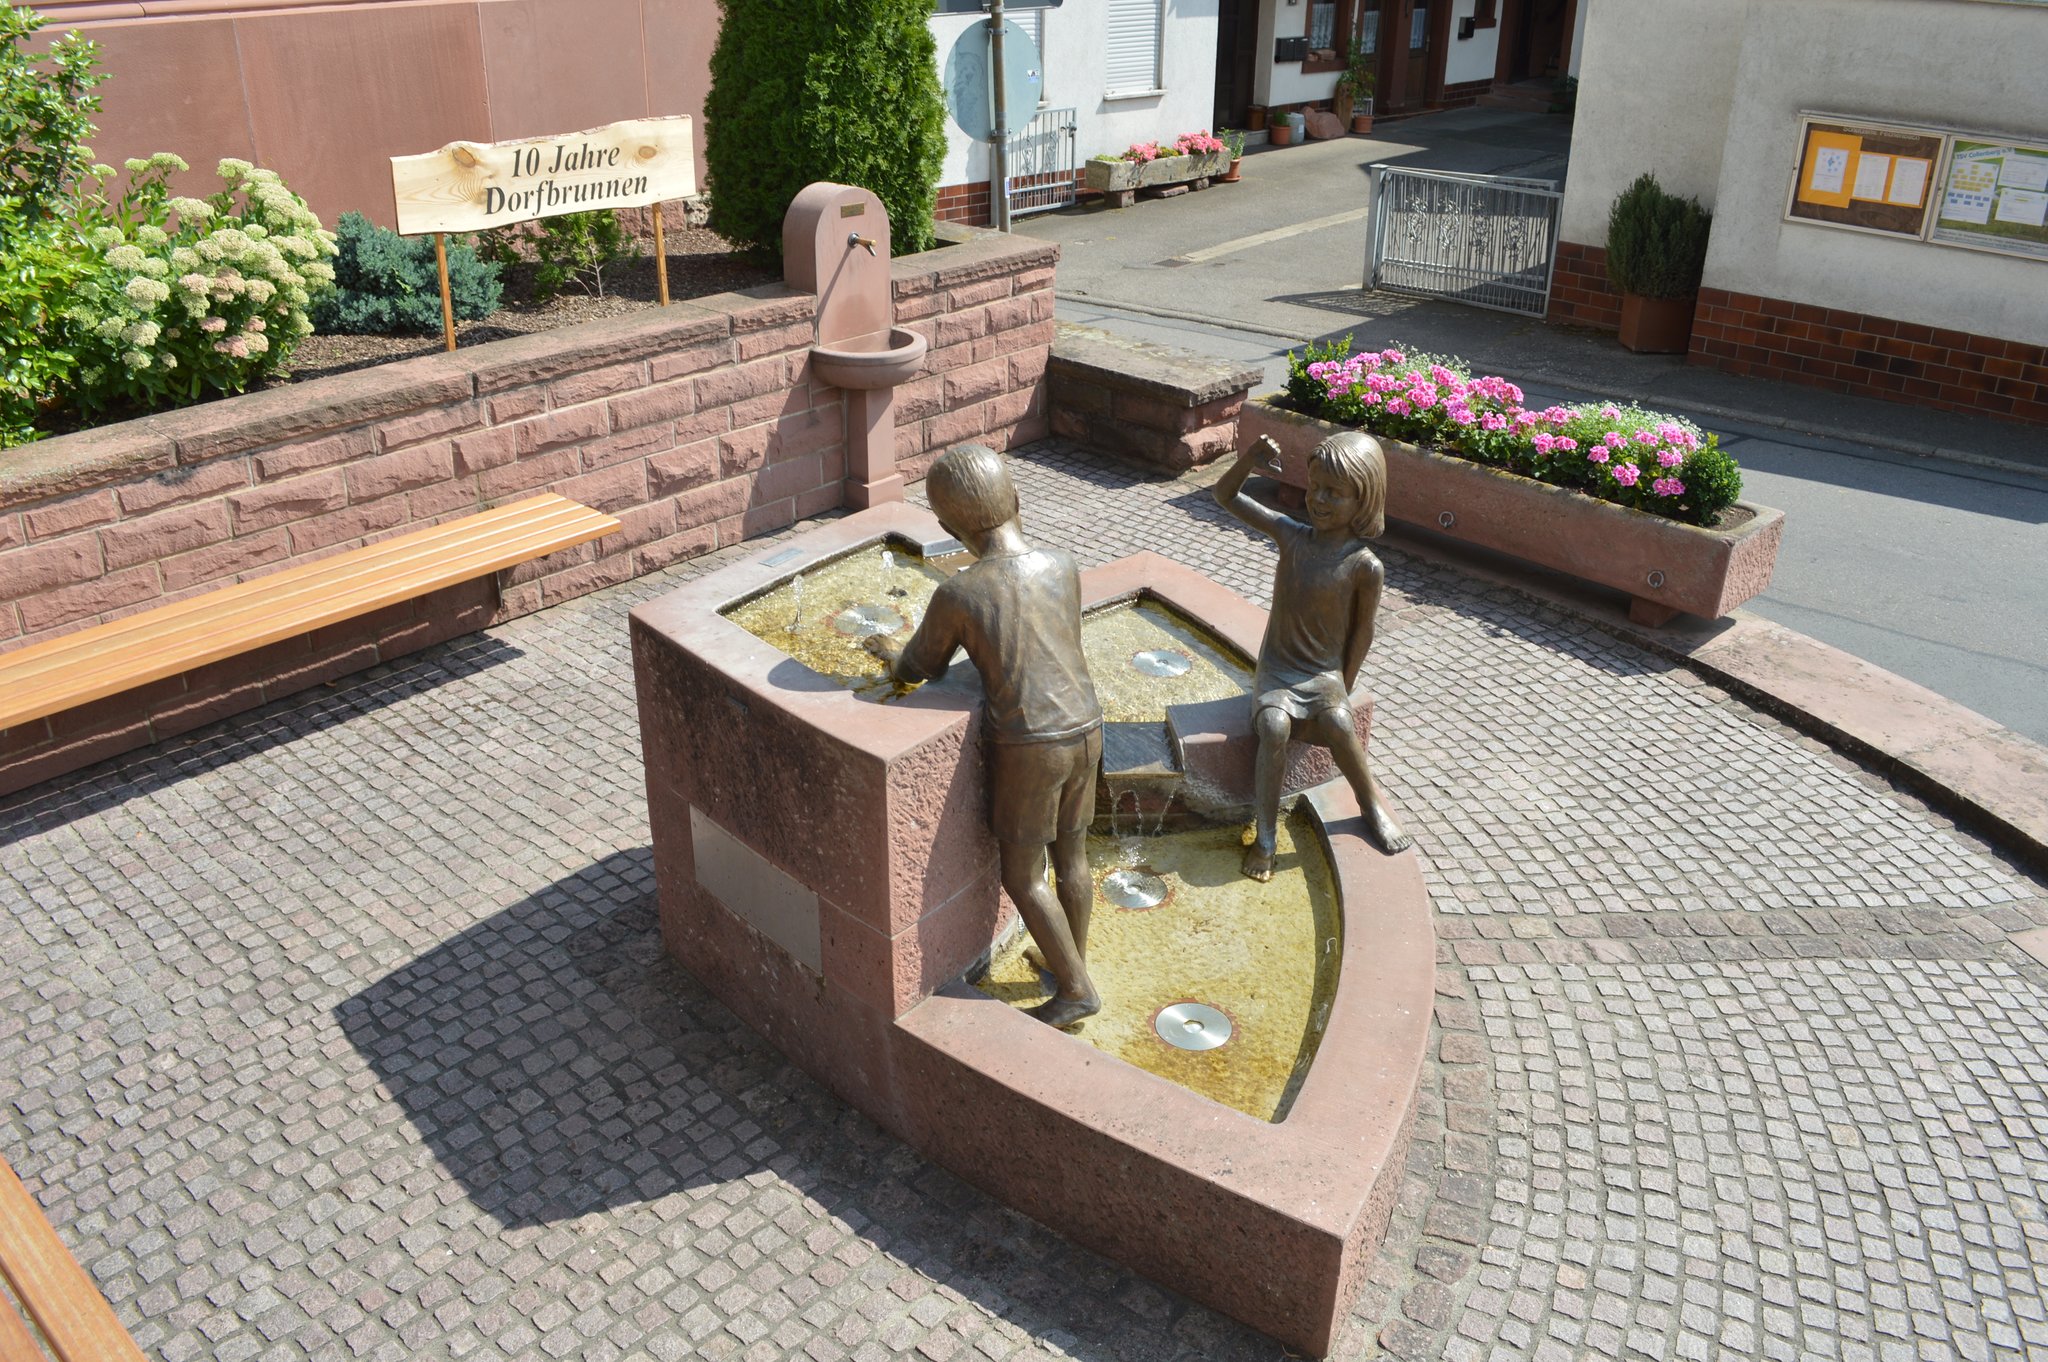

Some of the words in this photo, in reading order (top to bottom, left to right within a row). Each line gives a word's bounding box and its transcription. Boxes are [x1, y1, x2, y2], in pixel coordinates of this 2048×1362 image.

[512, 147, 540, 178] 10
[548, 143, 621, 175] Jahre
[484, 175, 648, 217] Dorfbrunnen
